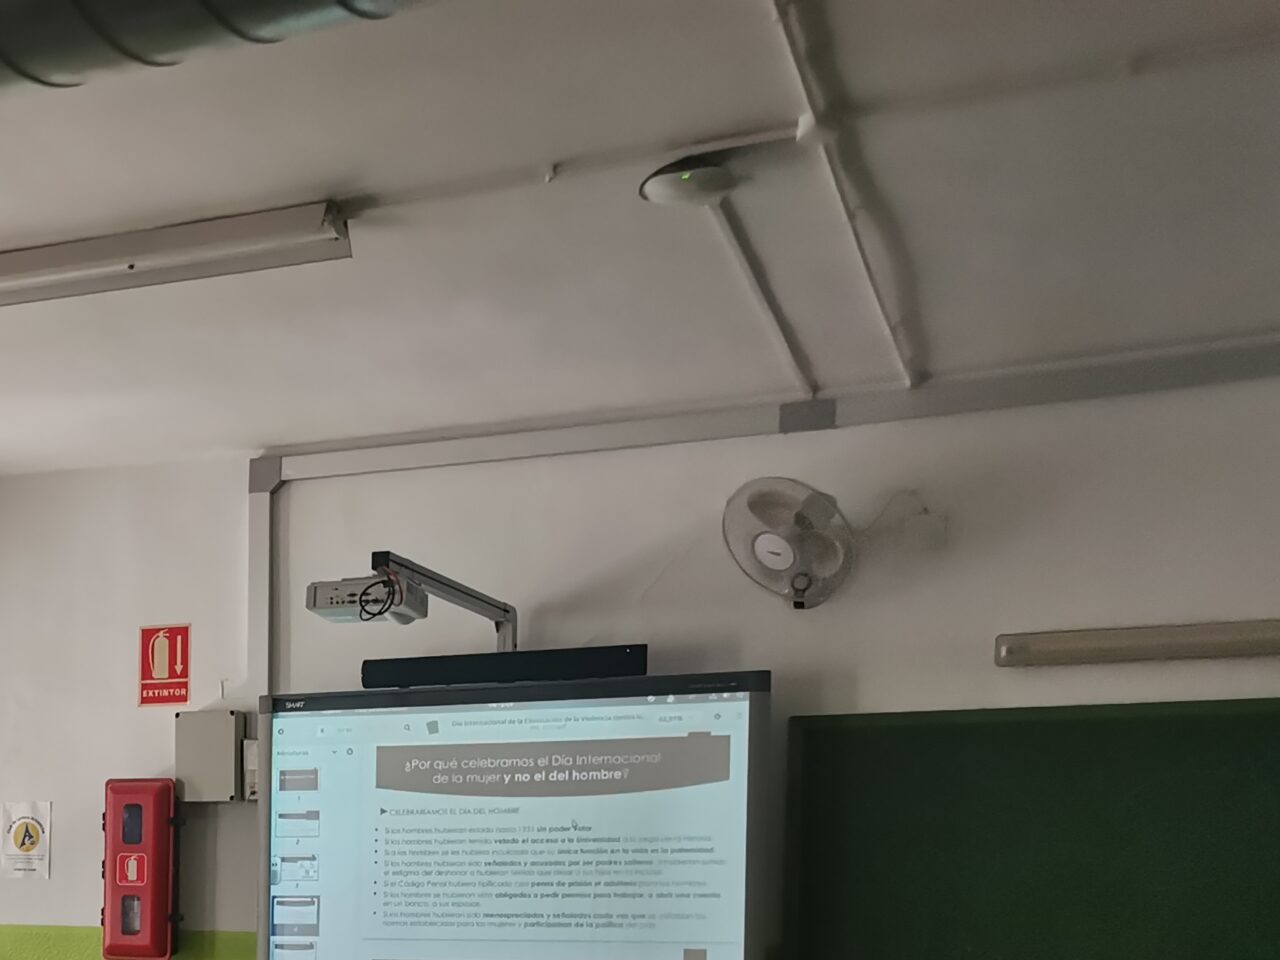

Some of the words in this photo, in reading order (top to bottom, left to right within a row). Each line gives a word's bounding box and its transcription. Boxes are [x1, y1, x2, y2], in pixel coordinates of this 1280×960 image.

[142, 688, 187, 698] EXTINTOR
[285, 700, 307, 709] SMART
[405, 759, 431, 772] ¿Por
[433, 757, 458, 770] qué
[461, 757, 535, 769] celebramos
[537, 755, 549, 767] el
[551, 754, 573, 766] Día
[576, 752, 662, 766] Internacional
[432, 773, 449, 784] de
[451, 773, 463, 784] la
[466, 773, 500, 785] mujer
[503, 773, 512, 785] y
[515, 772, 530, 782] no
[534, 770, 545, 782] el
[548, 769, 569, 781] del
[572, 767, 629, 781] hombre?
